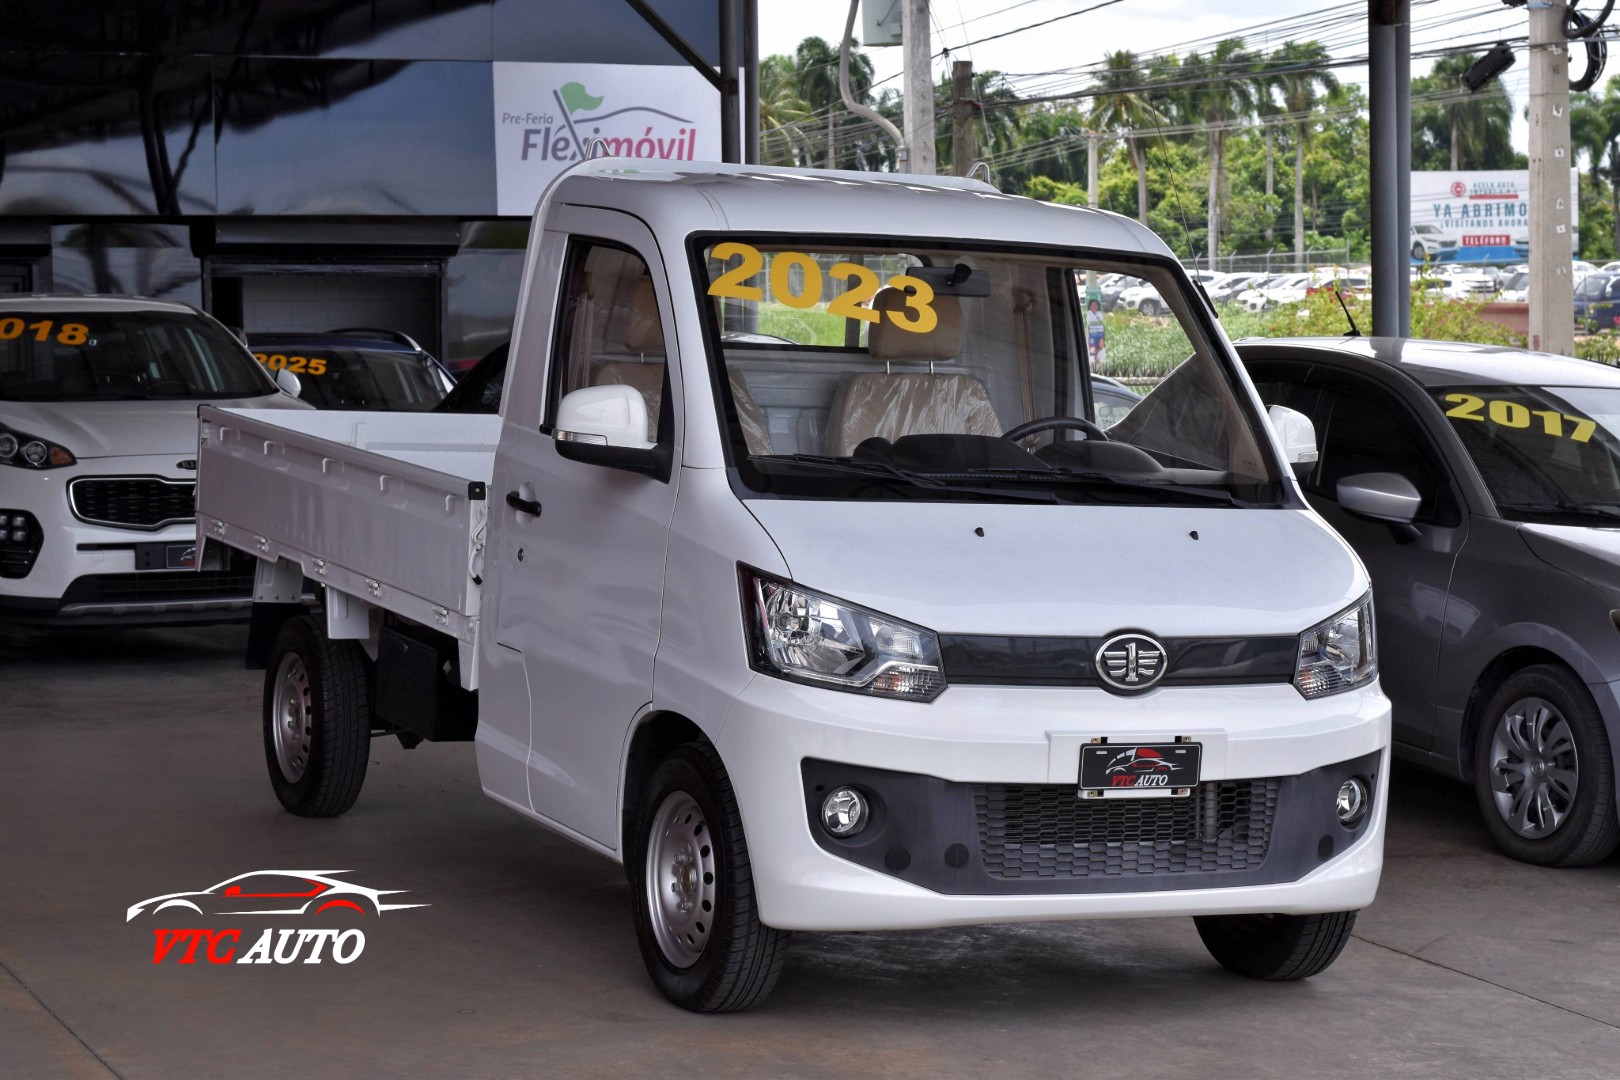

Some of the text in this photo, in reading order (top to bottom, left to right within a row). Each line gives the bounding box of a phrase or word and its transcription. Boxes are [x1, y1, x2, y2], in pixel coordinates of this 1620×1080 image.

[502, 112, 554, 125] Pre-Feria
[1433, 203, 1528, 218] YA ABRIMO
[707, 242, 937, 333] 2023
[0, 317, 90, 345] 018
[1445, 393, 1596, 443] 2017
[1112, 774, 1169, 787] VTC AUTO
